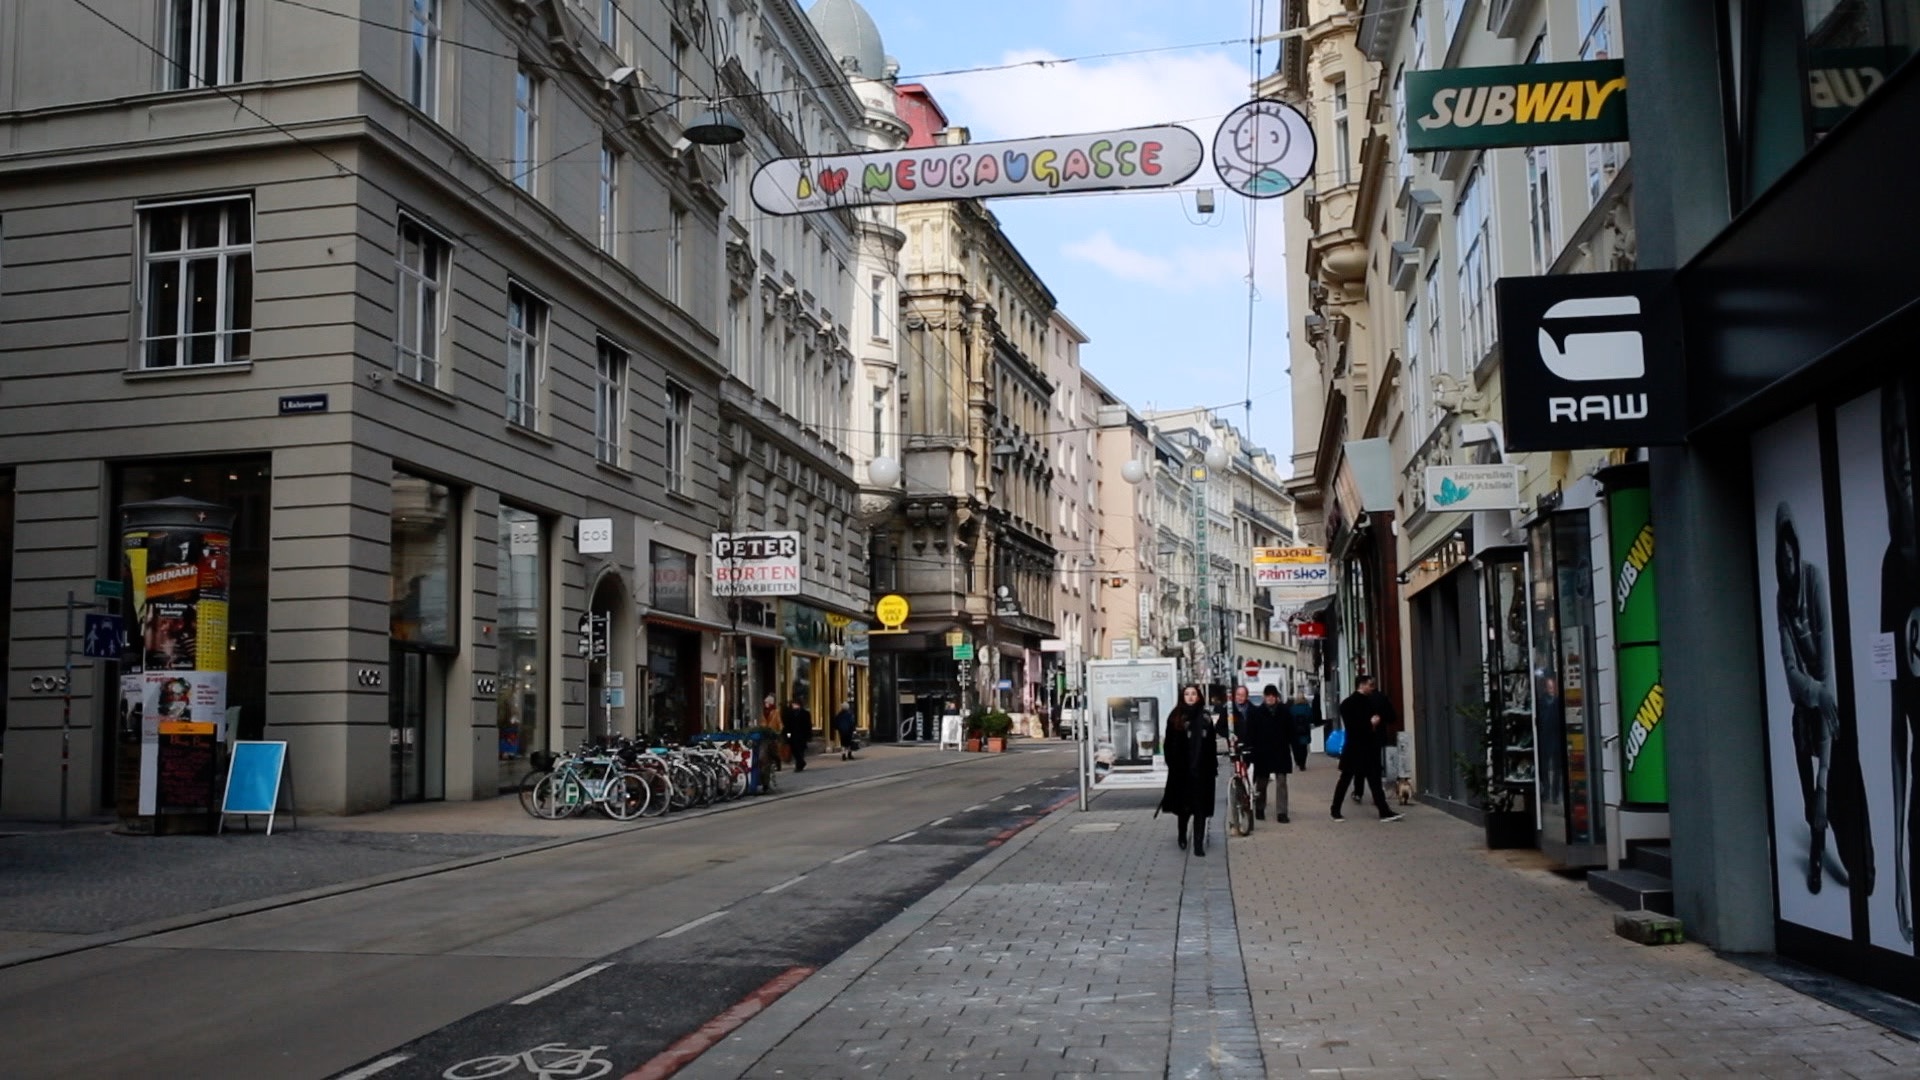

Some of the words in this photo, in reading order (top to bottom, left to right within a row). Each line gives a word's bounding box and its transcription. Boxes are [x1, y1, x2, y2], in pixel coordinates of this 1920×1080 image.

[1417, 76, 1628, 131] SUBWAY
[862, 140, 1165, 194] NEUBAUGASSE
[1549, 393, 1648, 423] RAW
[582, 530, 609, 542] COS
[718, 540, 796, 557] PETER
[716, 565, 797, 581] BORTEN
[1617, 524, 1656, 613] SUBWA
[716, 583, 797, 594] HANDARBEITEN
[30, 675, 68, 692] COS
